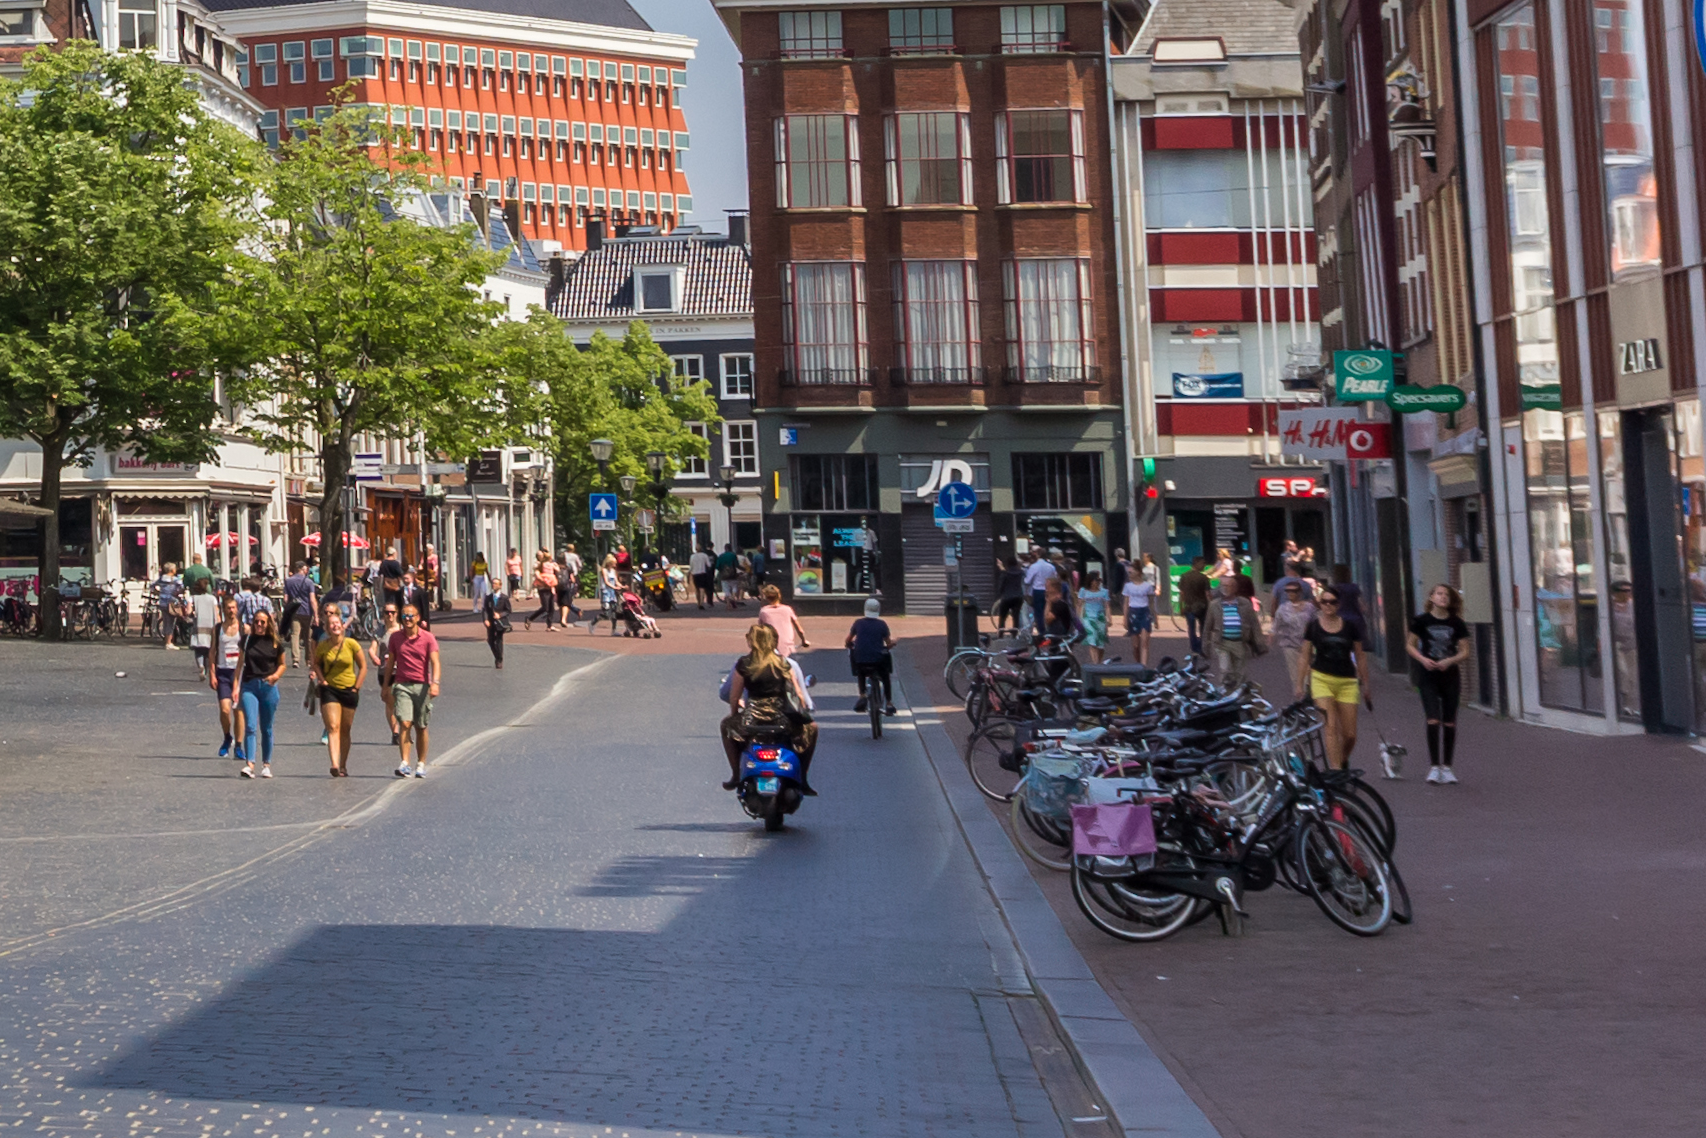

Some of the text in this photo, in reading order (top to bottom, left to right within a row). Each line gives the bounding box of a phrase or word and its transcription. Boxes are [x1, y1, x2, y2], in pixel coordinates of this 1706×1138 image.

[1619, 338, 1663, 375] ZARA
[1392, 392, 1460, 406] Specsavers
[917, 459, 973, 497] JD
